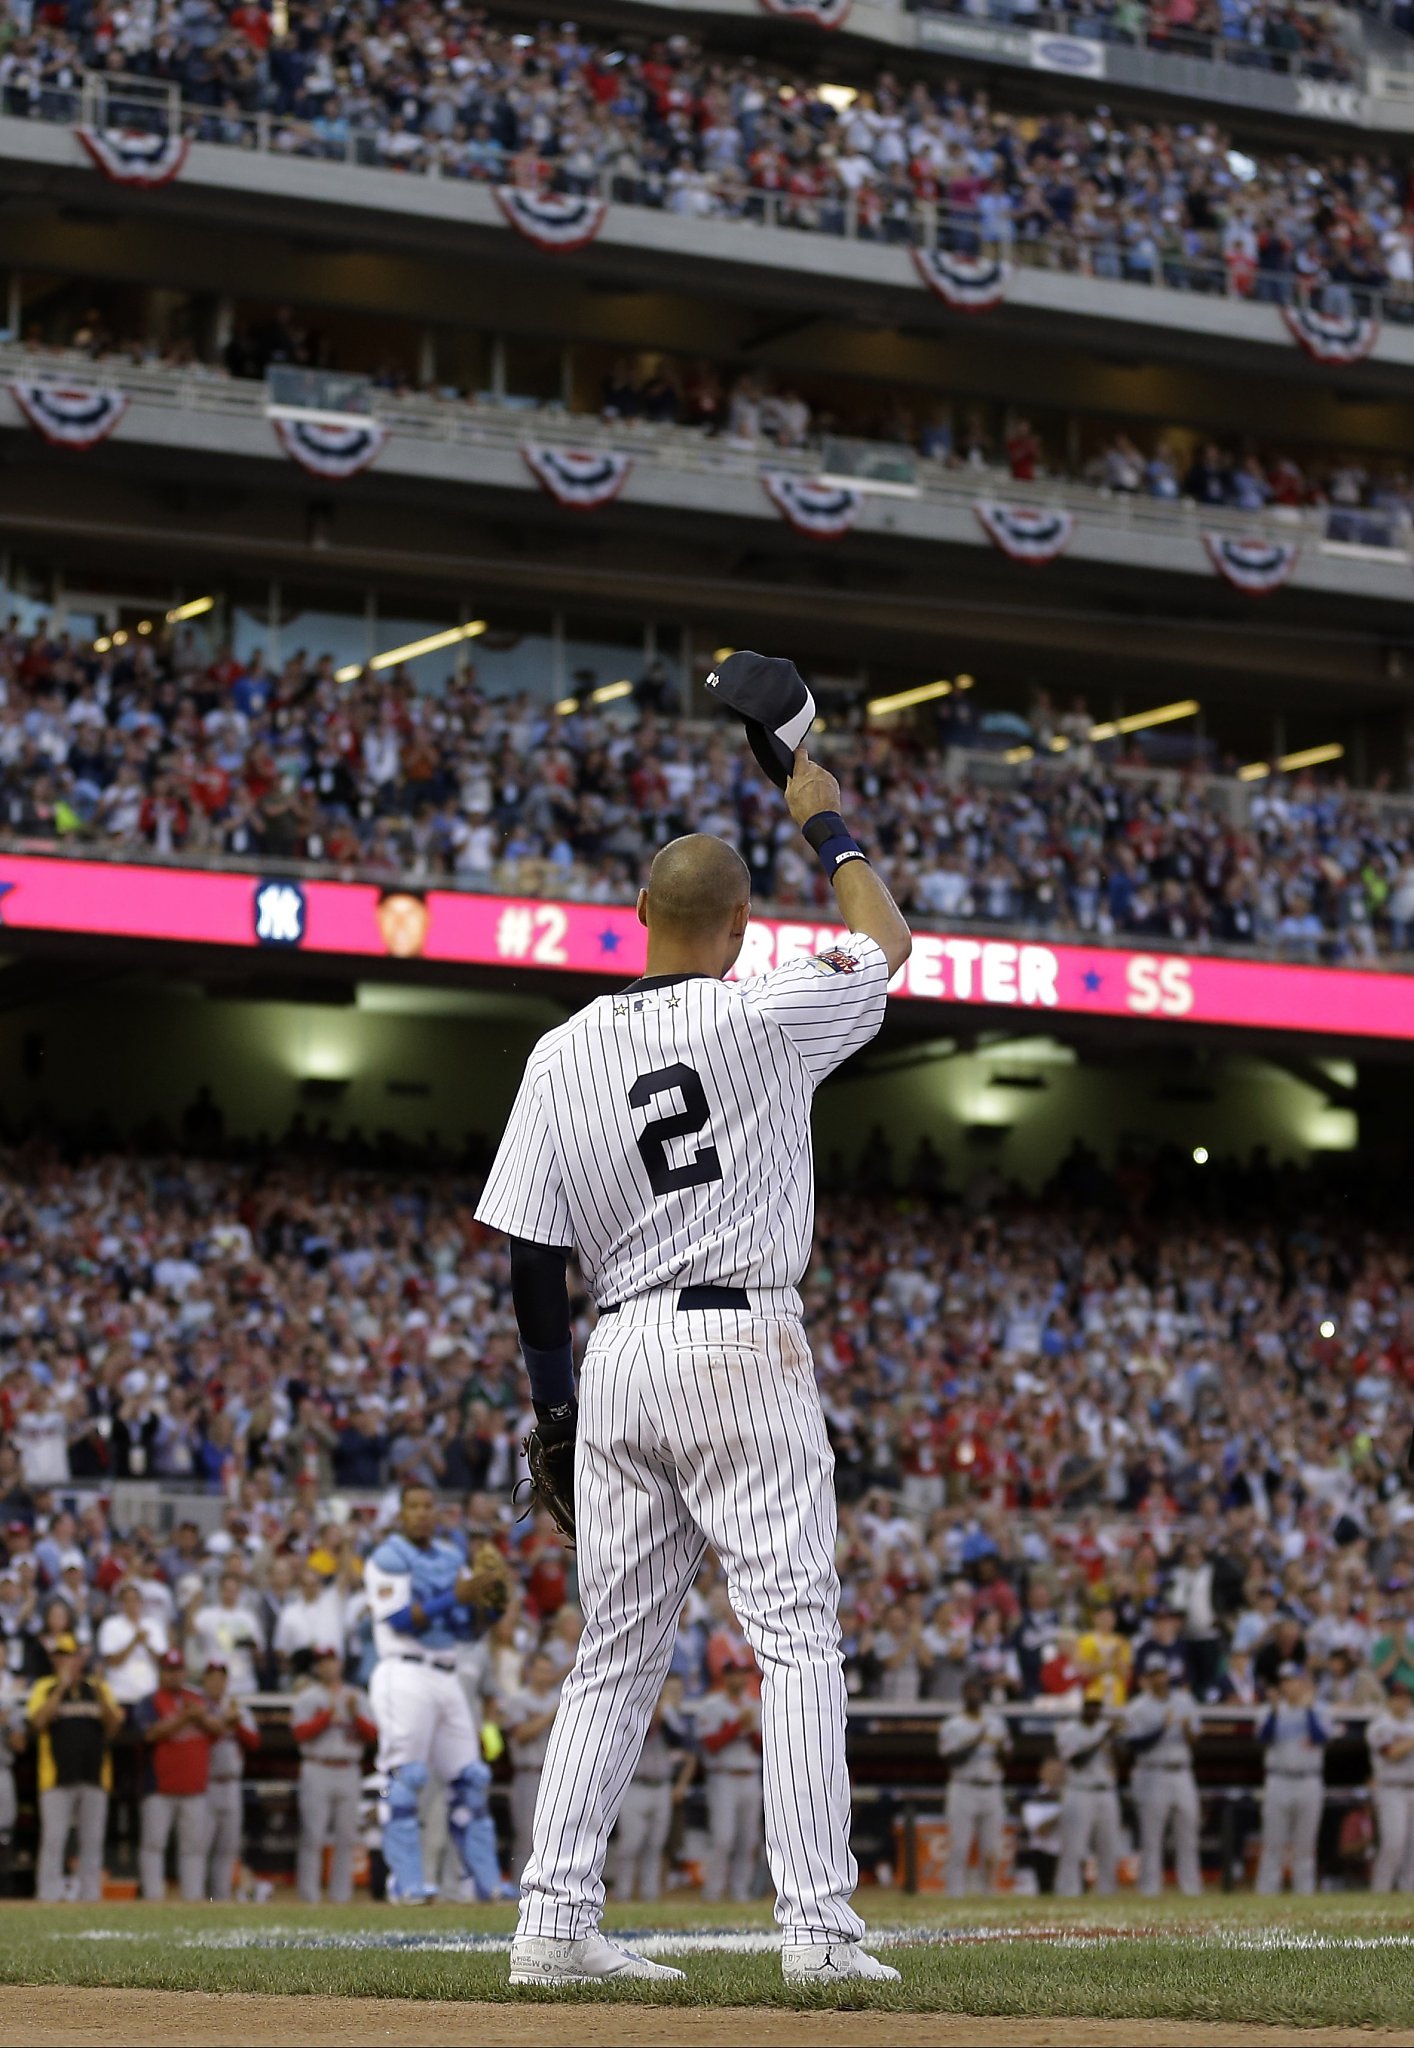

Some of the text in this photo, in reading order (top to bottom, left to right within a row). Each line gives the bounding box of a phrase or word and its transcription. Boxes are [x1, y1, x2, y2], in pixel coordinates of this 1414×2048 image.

[496, 904, 568, 965] #2
[1127, 954, 1194, 1017] SS
[628, 1062, 722, 1197] 2
